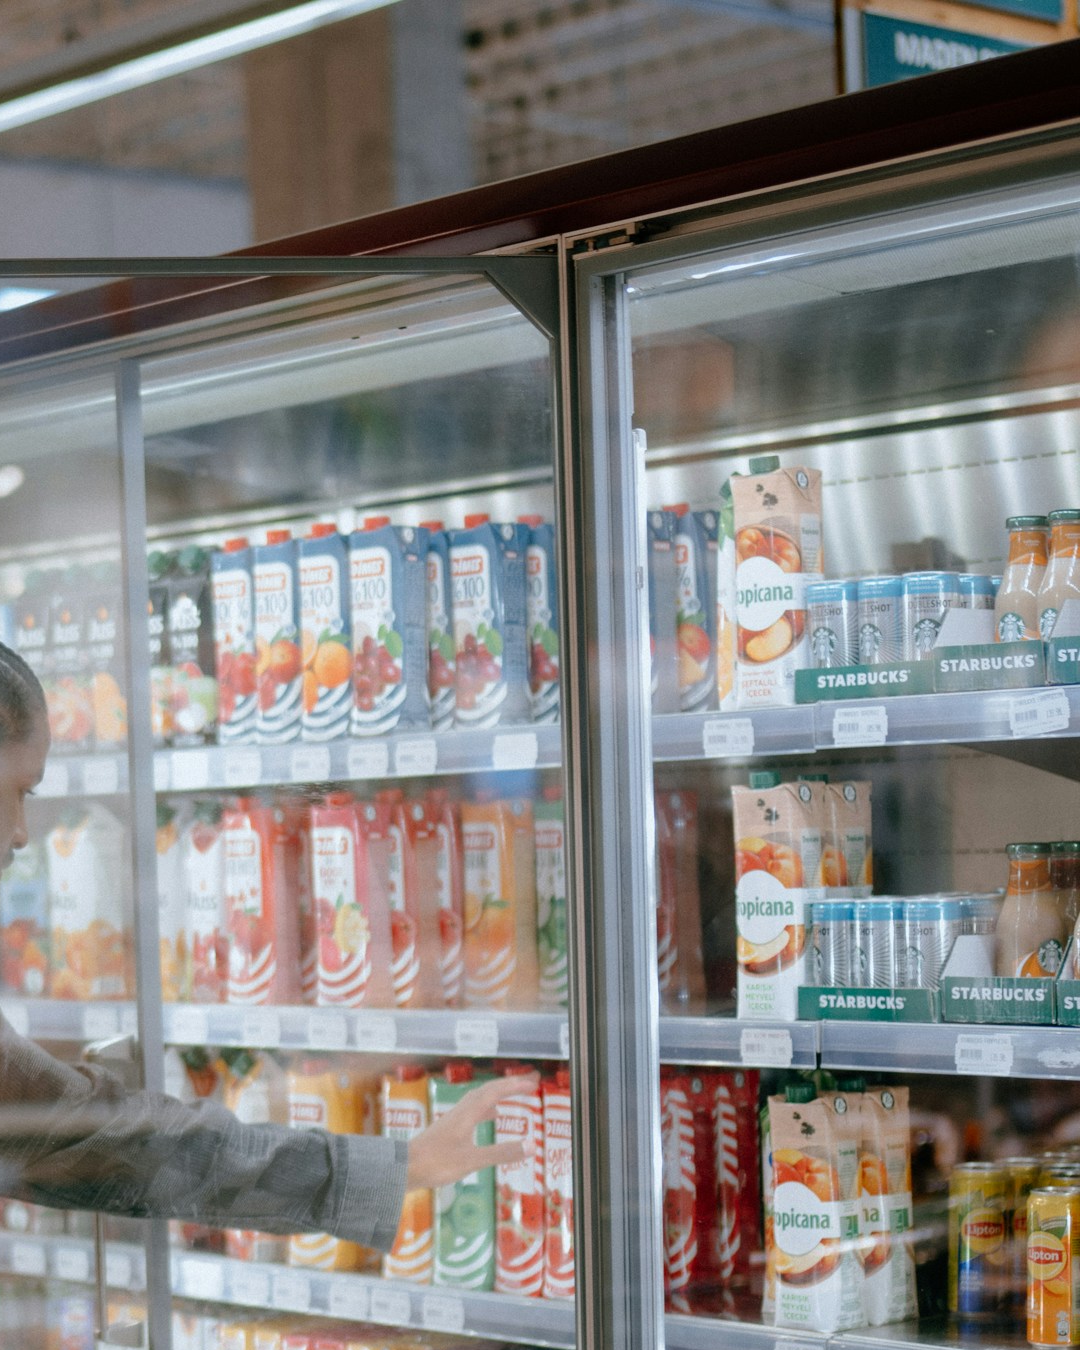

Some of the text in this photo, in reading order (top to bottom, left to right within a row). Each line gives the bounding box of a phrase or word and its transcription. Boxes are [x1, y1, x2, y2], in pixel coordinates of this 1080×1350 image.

[940, 654, 1036, 673] STARBUCKS
[817, 670, 909, 688] STARBUCKS
[951, 987, 1045, 1001] STARBUCKS
[819, 995, 905, 1009] STARBUCKS
[967, 1226, 1001, 1238] Lipton
